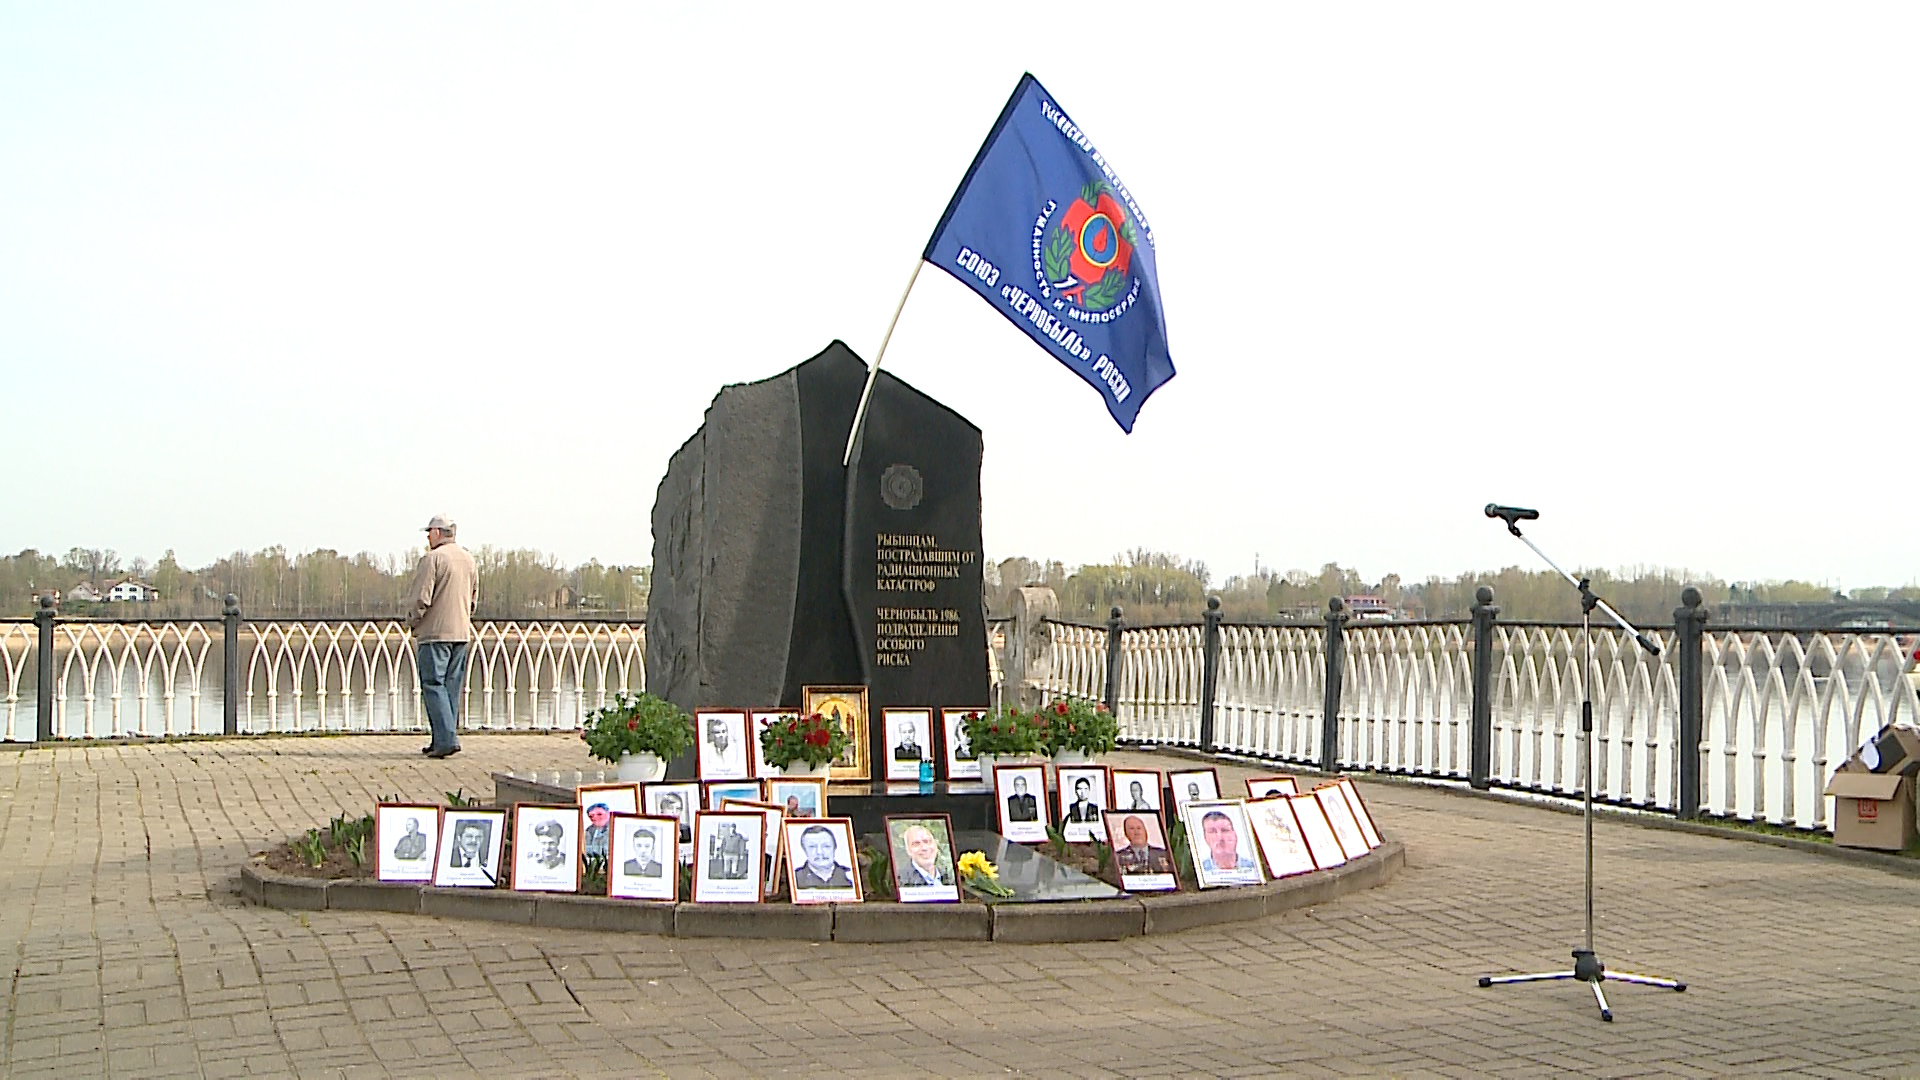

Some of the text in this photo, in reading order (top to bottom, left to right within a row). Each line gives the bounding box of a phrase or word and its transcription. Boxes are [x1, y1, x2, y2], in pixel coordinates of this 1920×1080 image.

[1032, 199, 1057, 299] ГУМАННОСТЬ
[1052, 299, 1066, 311] И
[956, 247, 1000, 287] СОЮЗ
[877, 549, 976, 564] ПОСТРАДАВШИМ ОТ
[877, 563, 960, 578] РАДИАЦИОННЫХ
[877, 579, 936, 592] КАТАСТРОФ
[877, 607, 939, 621] ЧЕРНОБЫЛЬ
[877, 623, 959, 637] ПОДРАЗДЕЛЕНИЯ
[876, 637, 926, 651] ОСОБОГО
[877, 653, 911, 666] РИСКА
